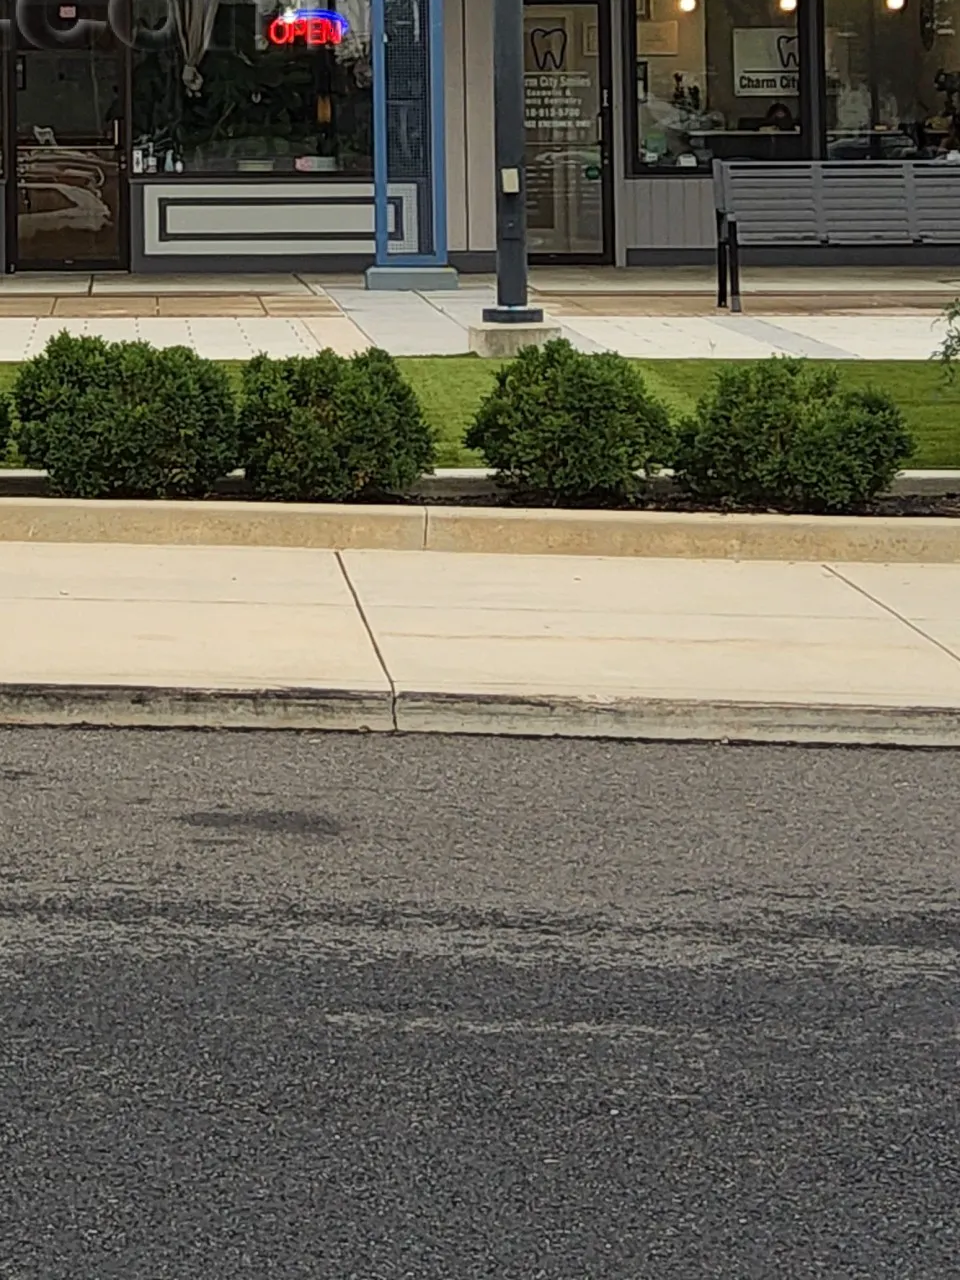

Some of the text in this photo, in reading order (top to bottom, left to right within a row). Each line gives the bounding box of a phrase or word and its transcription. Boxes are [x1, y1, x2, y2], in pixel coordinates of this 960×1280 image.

[269, 17, 342, 44] OPEN
[740, 75, 799, 89] Charm Cit
